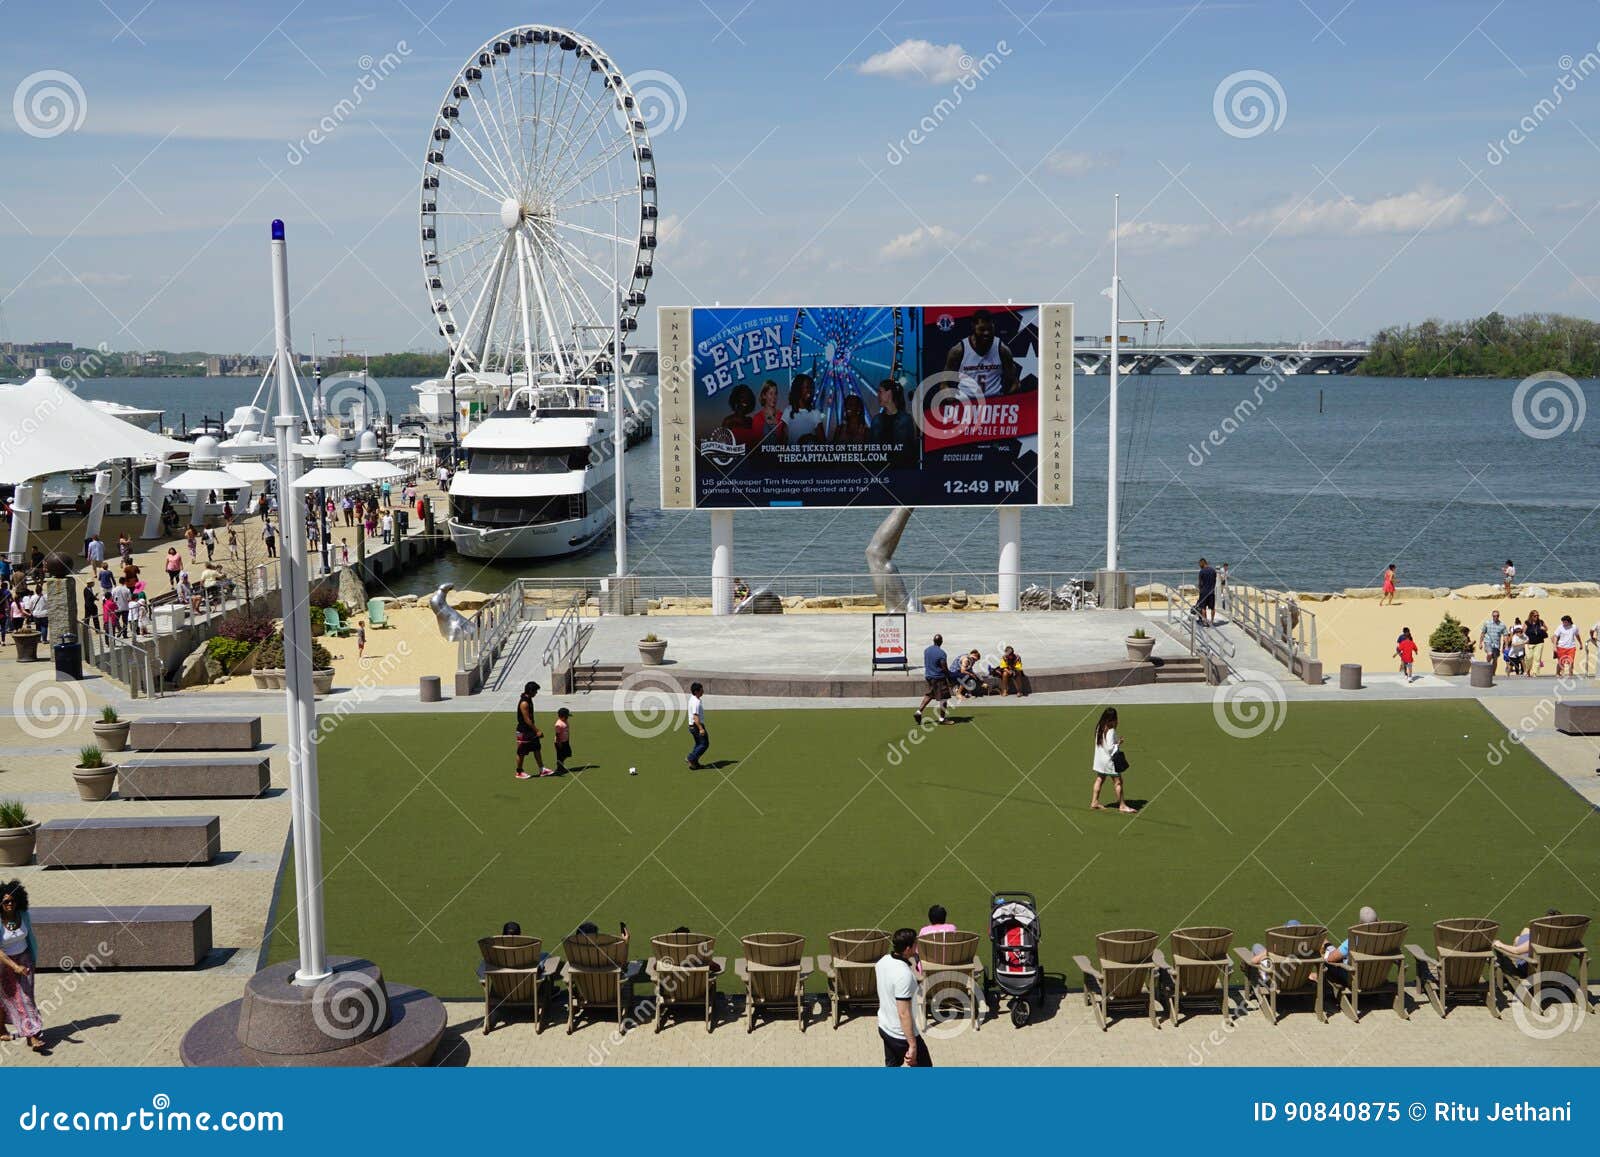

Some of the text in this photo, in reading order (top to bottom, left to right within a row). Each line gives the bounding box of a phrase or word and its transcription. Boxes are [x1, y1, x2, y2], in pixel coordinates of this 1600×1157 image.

[710, 325, 782, 366] EVEN
[701, 346, 801, 396] BETTER!
[671, 323, 681, 494] NATIONAL HARBOR
[1053, 320, 1062, 491] NATIONAL HARBOR
[942, 404, 1020, 425] PLAYOFFS
[964, 426, 1018, 436] ON SALE NOW
[761, 444, 800, 453] PURCHASE
[802, 444, 835, 452] TICKETS
[835, 444, 846, 452] ON
[847, 444, 864, 452] THE
[882, 443, 893, 451] OR
[893, 443, 904, 451] AT
[778, 453, 888, 463] THECAPITALWHEEL.COM
[702, 476, 890, 489] US goalkeeper Tim Howard suspended 3 MLS
[943, 480, 1020, 493] 12:49 PM
[702, 487, 730, 496] games
[732, 486, 744, 494] for
[745, 486, 761, 494] foul
[763, 486, 801, 496] language
[802, 485, 837, 494] directed
[838, 485, 847, 493] at
[856, 485, 870, 493] fan
